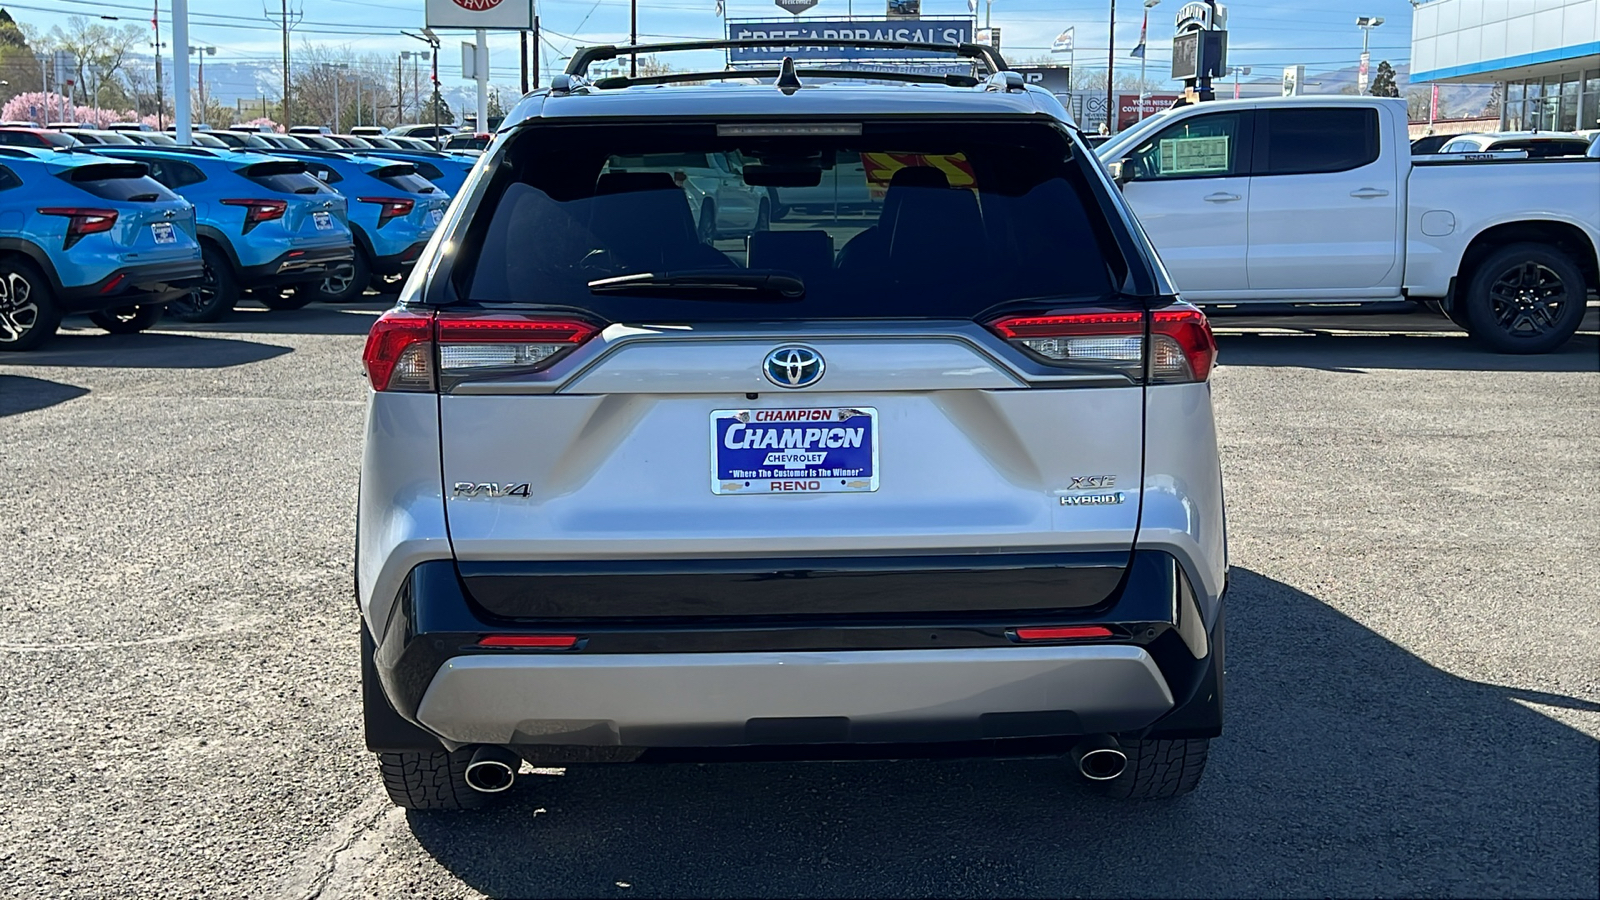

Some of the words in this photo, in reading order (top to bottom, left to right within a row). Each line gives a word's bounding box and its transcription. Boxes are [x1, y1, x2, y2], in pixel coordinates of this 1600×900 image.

[738, 30, 799, 53] FREE
[898, 65, 926, 73] Blue
[930, 66, 962, 74] Book
[755, 410, 832, 422] CHAMPION
[724, 423, 864, 450] CHAMPION
[768, 453, 822, 463] CHEVROLET
[758, 469, 772, 478] The
[773, 469, 808, 478] Customer
[809, 468, 817, 477] Is
[818, 468, 831, 477] The
[770, 481, 820, 491] RENO
[1067, 475, 1116, 489] XSE
[453, 482, 533, 499] RAV4
[1060, 494, 1117, 506] HYBRID
